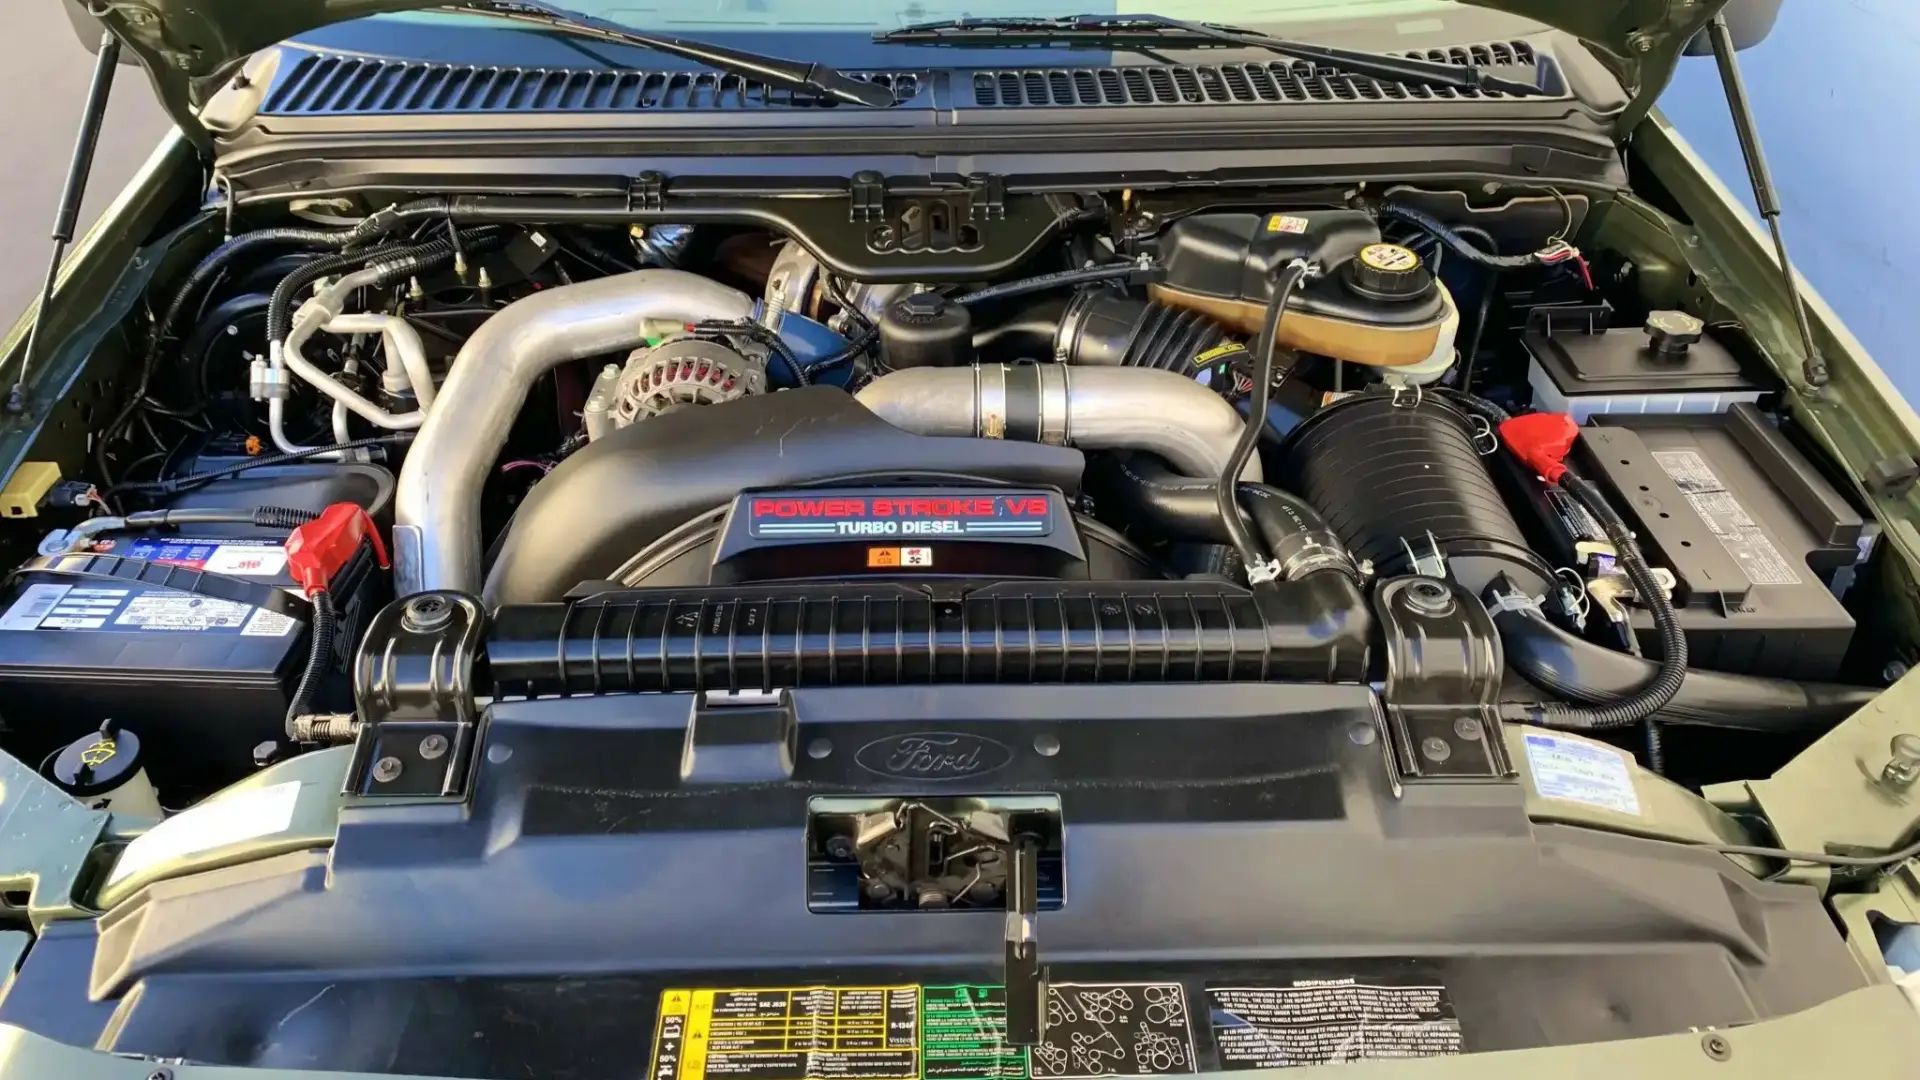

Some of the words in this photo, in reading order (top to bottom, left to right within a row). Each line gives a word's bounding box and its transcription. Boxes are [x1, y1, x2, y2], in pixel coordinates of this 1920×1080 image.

[754, 499, 864, 517] POWER
[872, 497, 993, 516] STROKE
[1003, 498, 1047, 516] V8
[837, 521, 897, 534] TURBO
[902, 521, 964, 534] DIESEL
[887, 737, 982, 771] Ford
[1292, 978, 1354, 987] MODIFICATIONS
